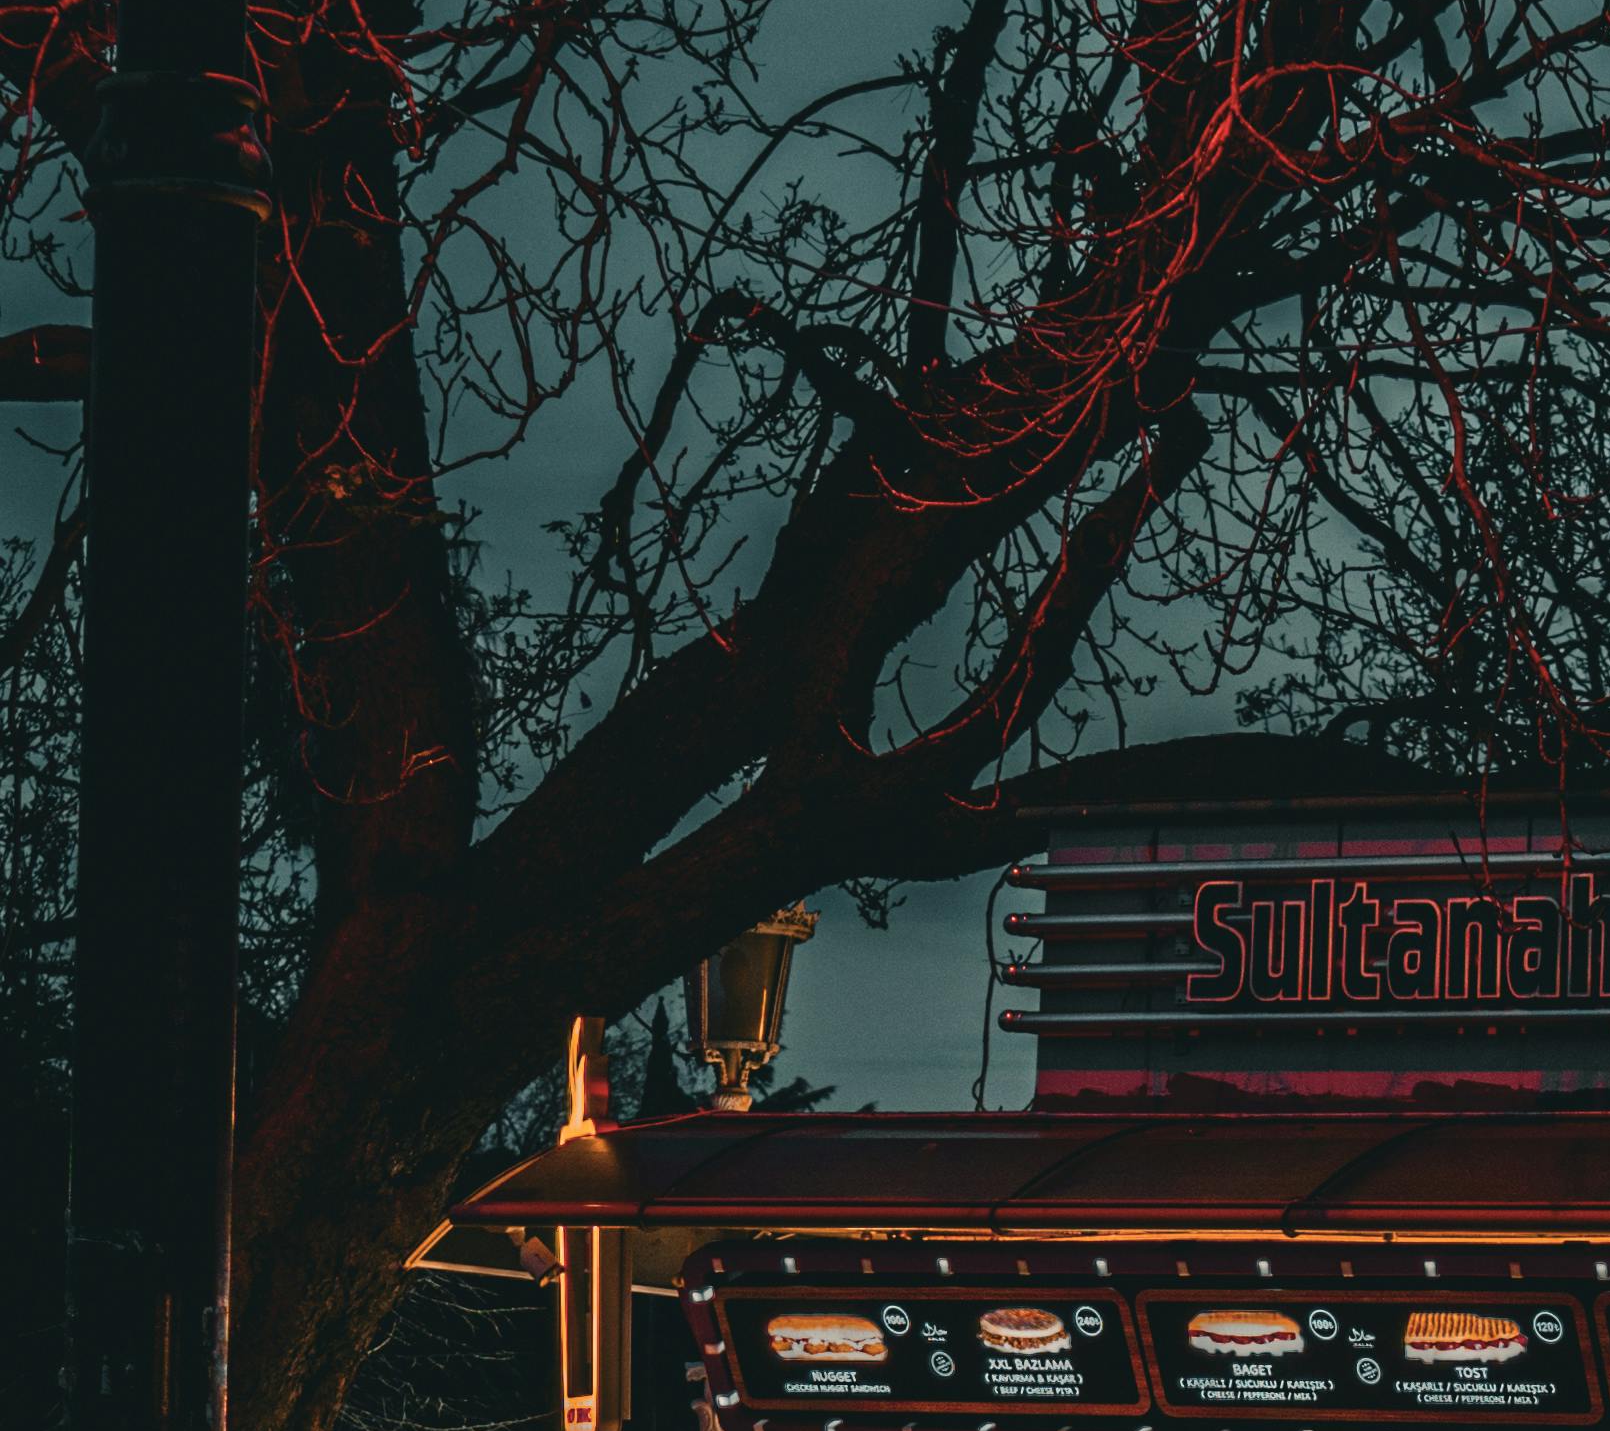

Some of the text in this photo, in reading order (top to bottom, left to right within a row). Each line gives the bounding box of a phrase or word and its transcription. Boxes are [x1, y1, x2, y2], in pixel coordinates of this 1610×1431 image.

[988, 1358, 1073, 1372] XXL BAZLAMA
[1232, 1364, 1274, 1377] BAGET
[811, 1371, 857, 1383] NUGGET
[1456, 1367, 1489, 1380] TOST
